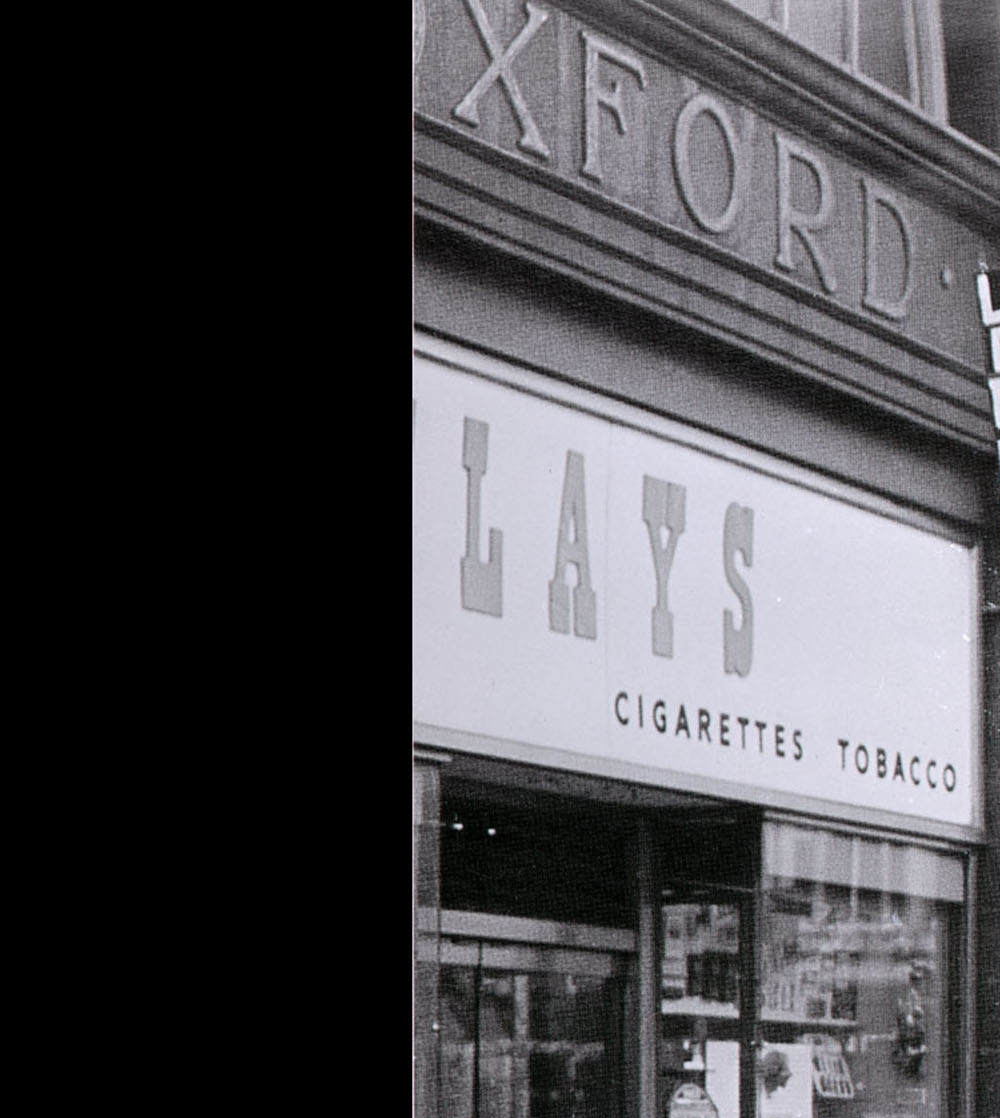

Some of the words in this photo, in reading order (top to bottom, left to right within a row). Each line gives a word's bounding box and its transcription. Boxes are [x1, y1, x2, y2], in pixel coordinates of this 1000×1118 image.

[413, 0, 913, 320] XFORD
[460, 416, 754, 678] LAYS
[614, 690, 803, 761] CIGARETTES
[837, 737, 957, 793] TOBACCO
